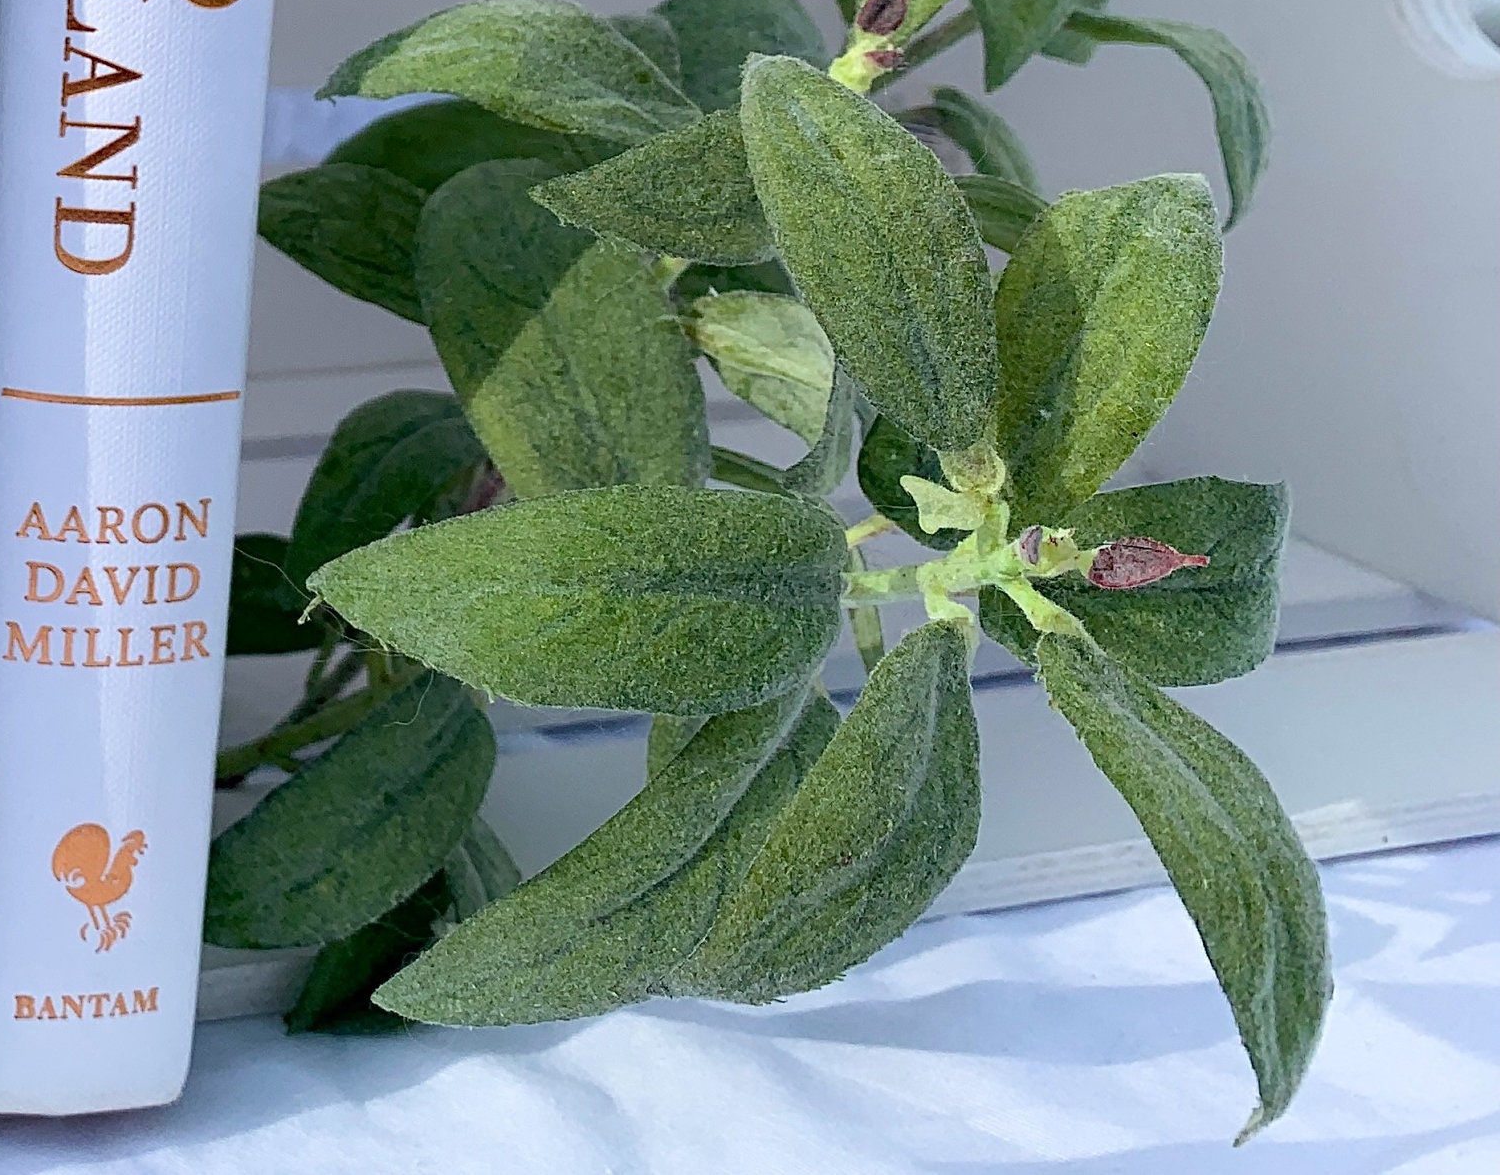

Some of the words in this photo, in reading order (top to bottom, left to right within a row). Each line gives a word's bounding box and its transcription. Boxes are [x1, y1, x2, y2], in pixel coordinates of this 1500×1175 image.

[15, 498, 212, 544] AARON
[23, 560, 202, 606] DAVID
[2, 621, 211, 668] MILLER
[14, 986, 160, 1021] BANTAM
